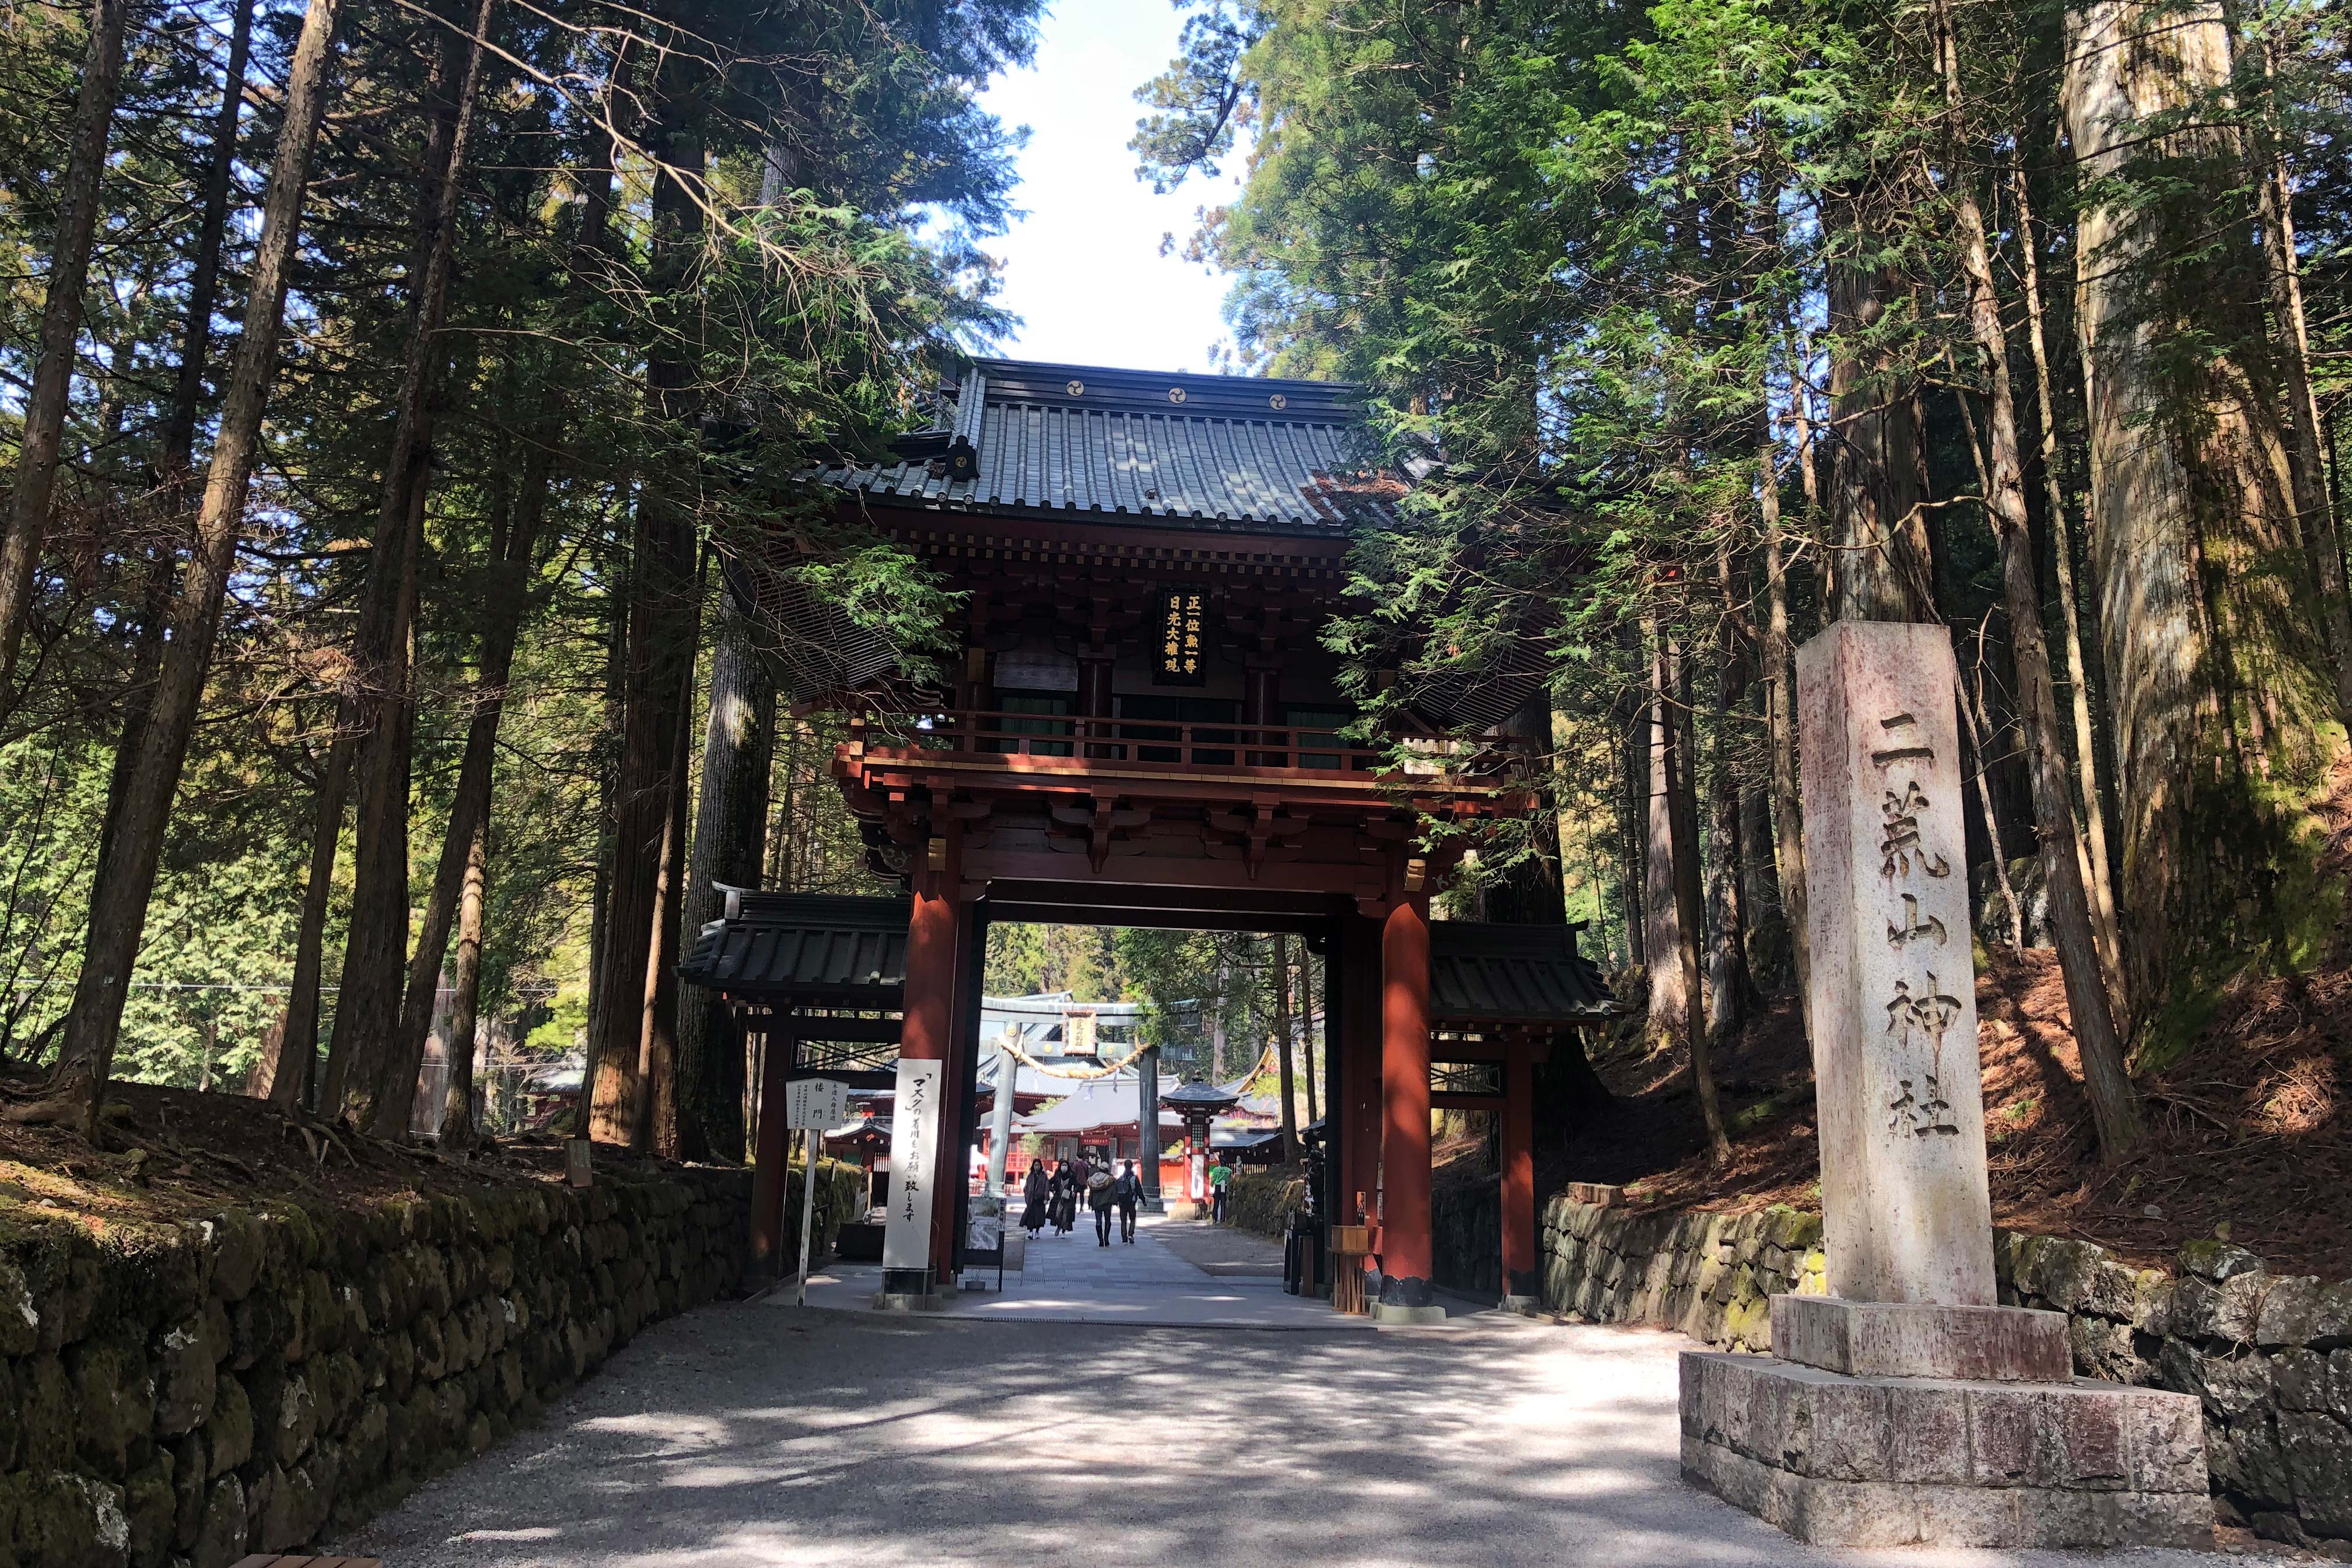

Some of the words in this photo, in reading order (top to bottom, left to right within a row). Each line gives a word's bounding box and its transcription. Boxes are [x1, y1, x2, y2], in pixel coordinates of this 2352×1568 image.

[1871, 712, 1962, 1139] 二荒山神社
